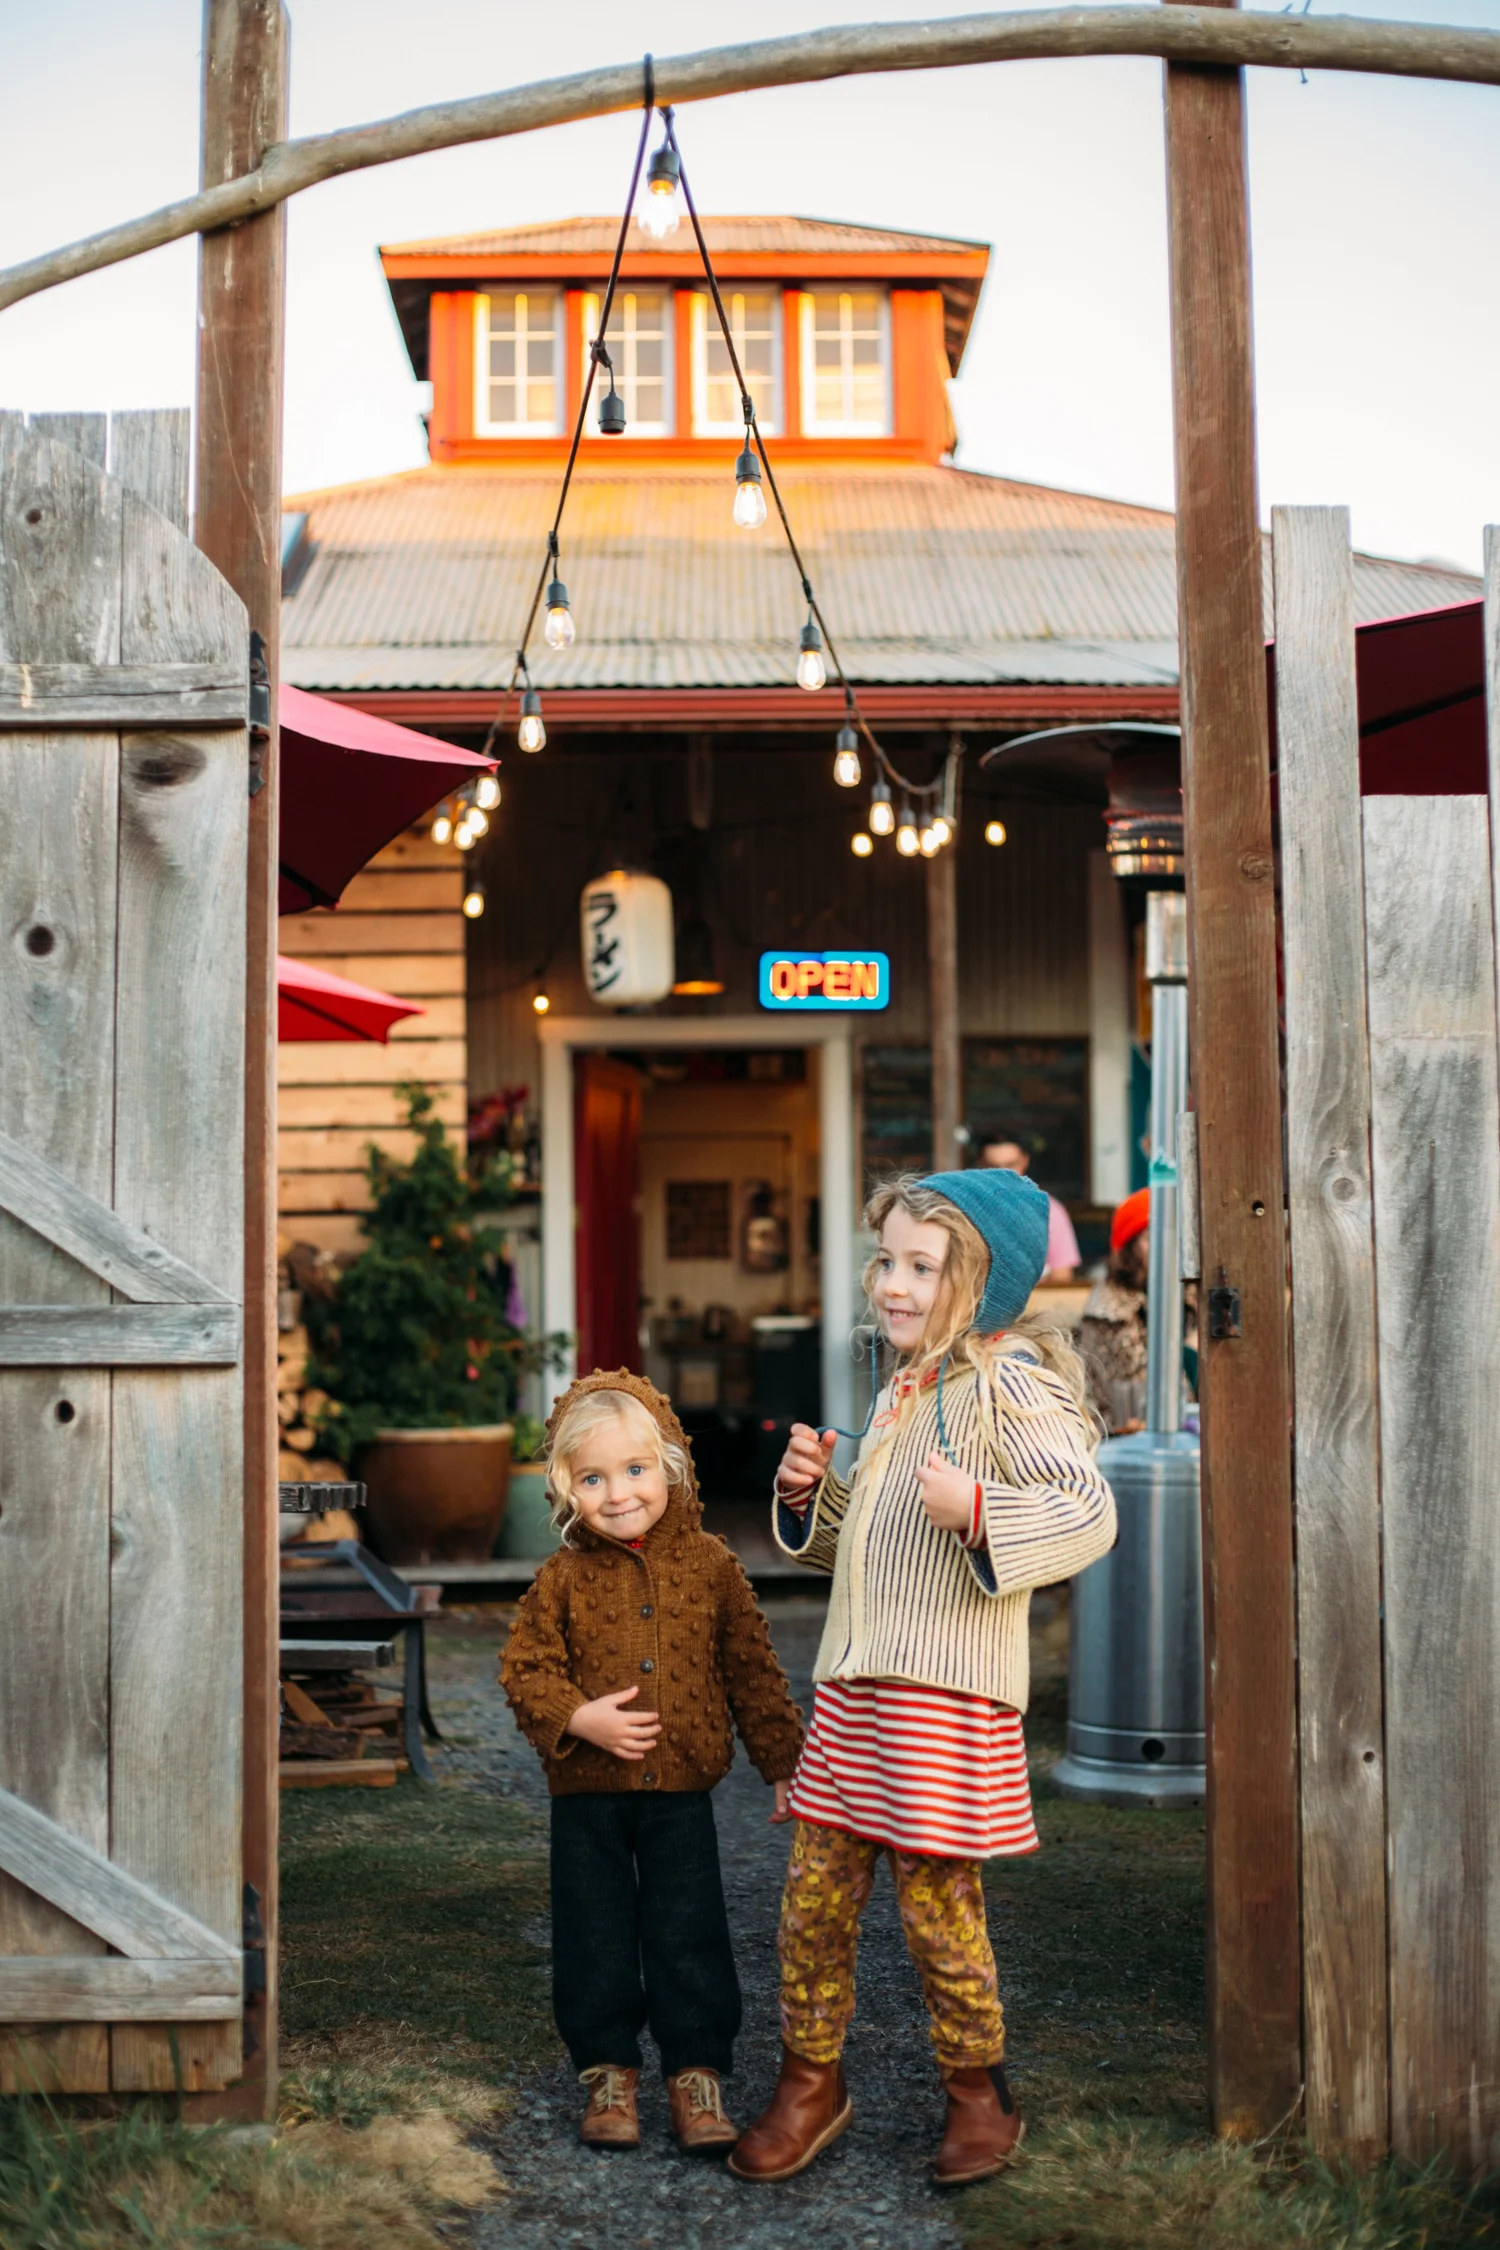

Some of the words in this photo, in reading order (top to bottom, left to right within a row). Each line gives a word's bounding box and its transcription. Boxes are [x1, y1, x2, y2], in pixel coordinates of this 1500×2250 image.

[588, 892, 622, 992] ラーメン
[769, 960, 880, 1001] OPEN
